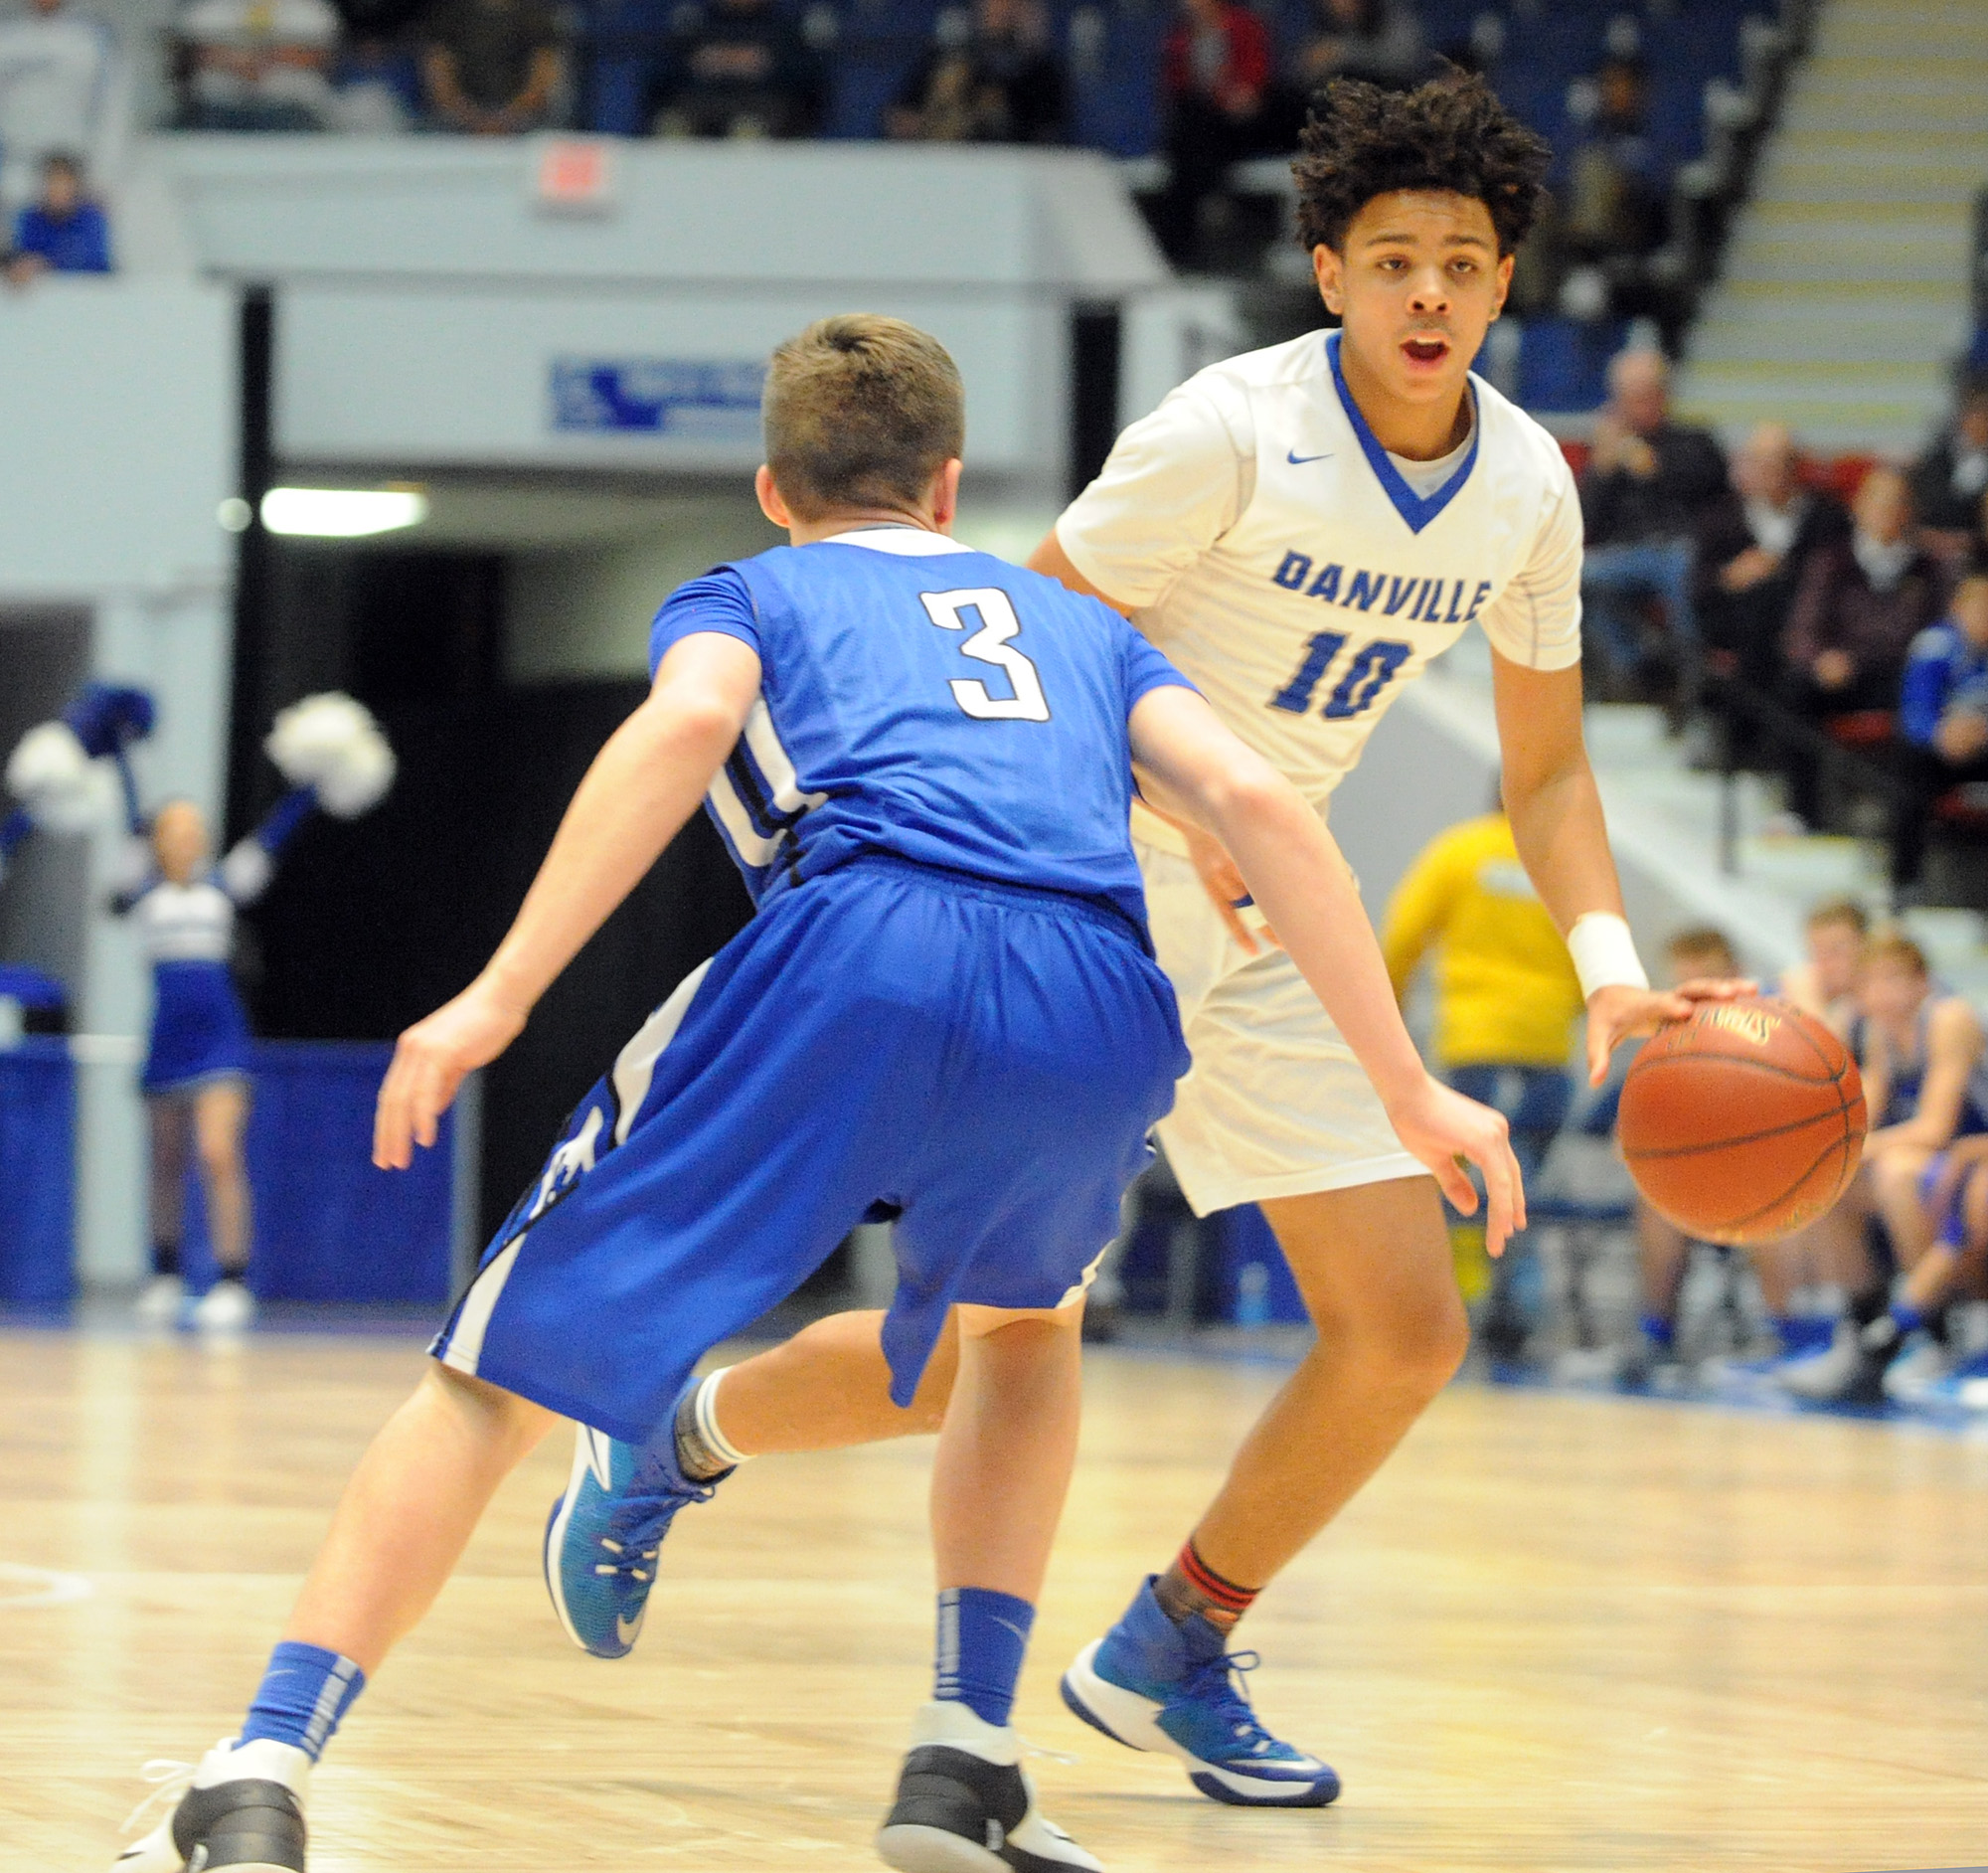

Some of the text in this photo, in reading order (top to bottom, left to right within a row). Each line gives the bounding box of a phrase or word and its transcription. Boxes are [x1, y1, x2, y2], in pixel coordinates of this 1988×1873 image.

[1272, 549, 1492, 623] DANVILLE
[917, 587, 1053, 724] 3
[1265, 627, 1415, 722] 10
